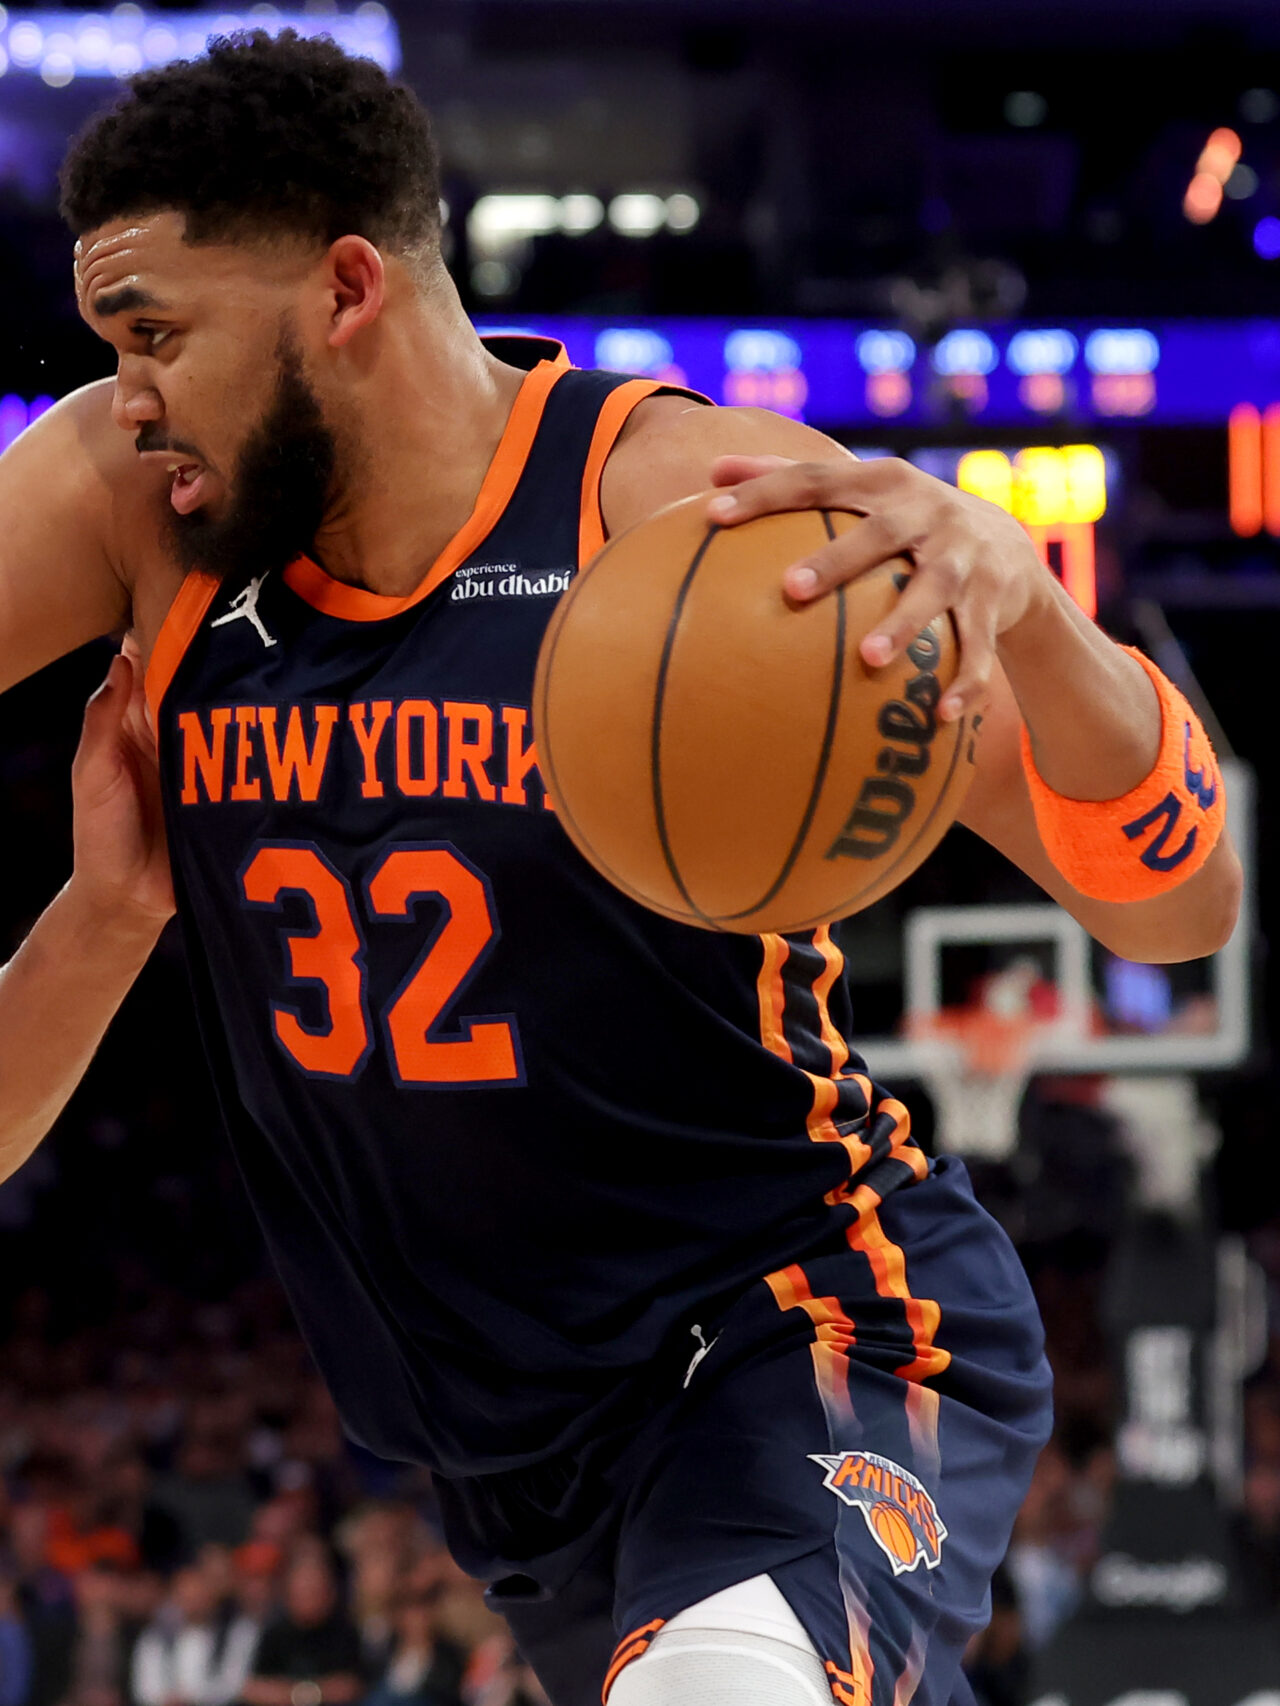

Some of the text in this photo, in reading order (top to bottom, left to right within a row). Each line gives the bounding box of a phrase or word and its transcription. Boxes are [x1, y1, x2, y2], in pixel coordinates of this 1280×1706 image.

[451, 570, 571, 601] abu dhabi
[455, 563, 517, 578] experience
[177, 698, 557, 812] NEW YORK
[823, 574, 942, 861] Wilso
[1121, 719, 1217, 872] 32
[237, 840, 528, 1089] 32
[832, 1456, 939, 1558] KNICKS
